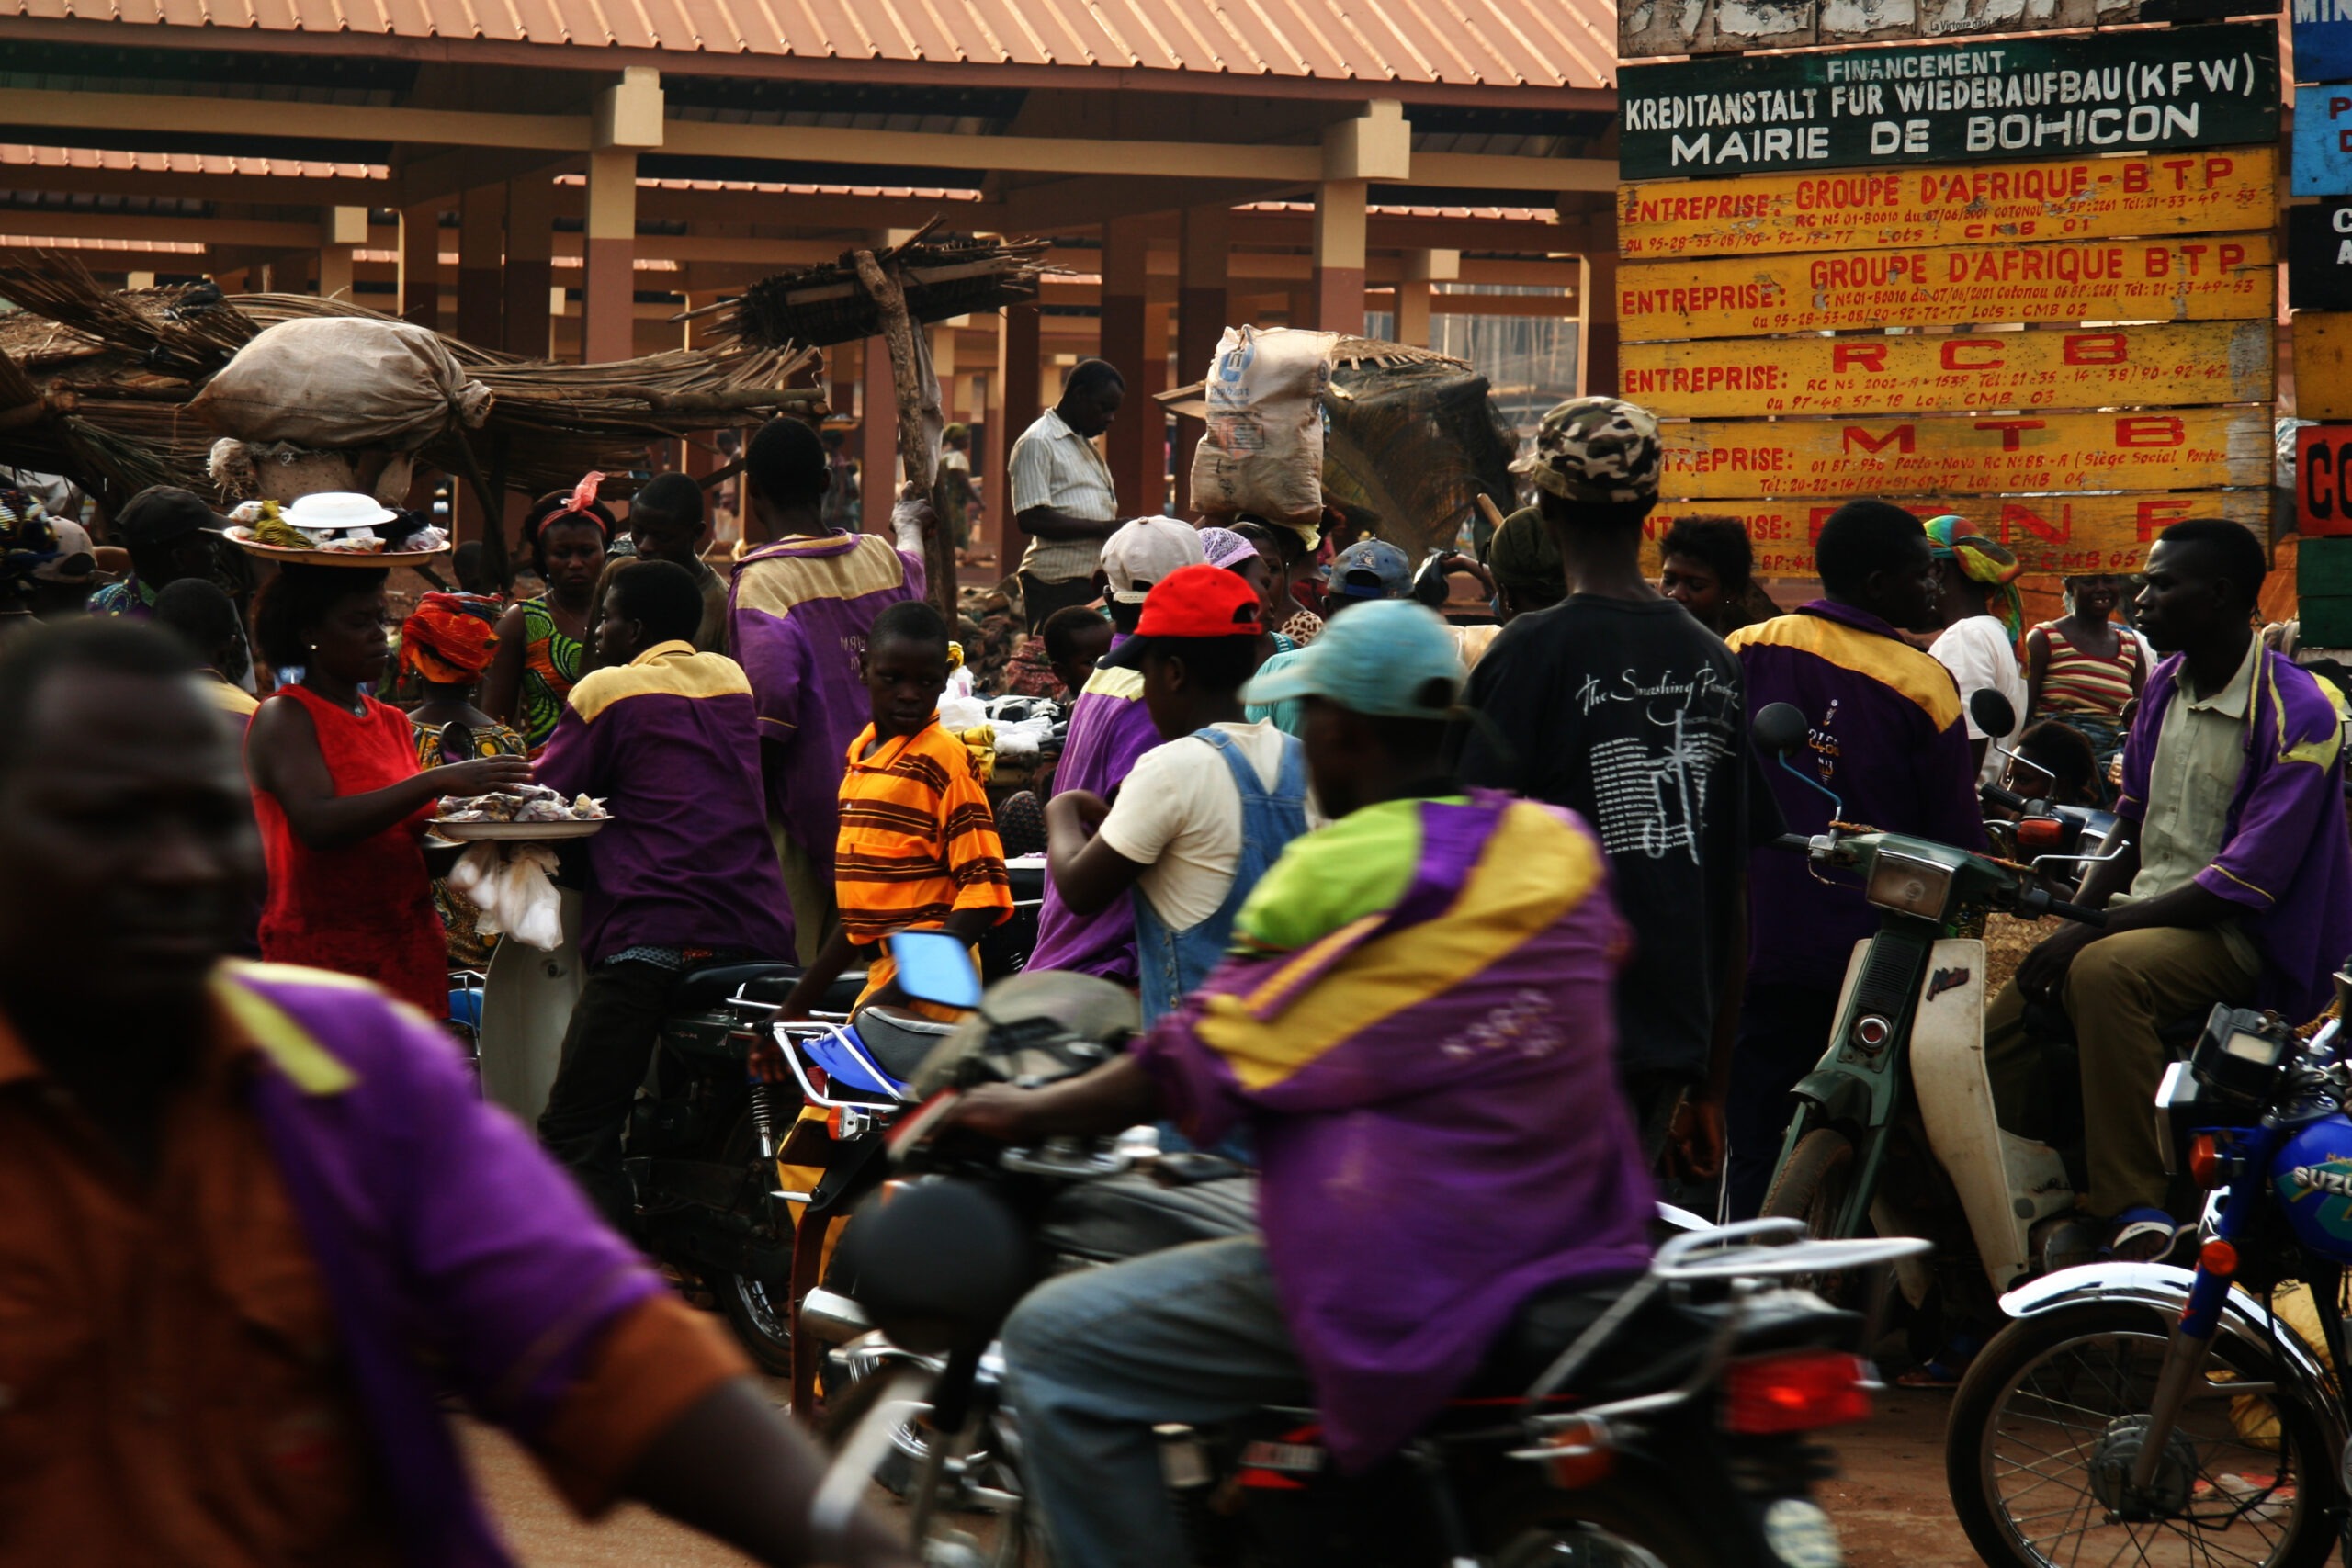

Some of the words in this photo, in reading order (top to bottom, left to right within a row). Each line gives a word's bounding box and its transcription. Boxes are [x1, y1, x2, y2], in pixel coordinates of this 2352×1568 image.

[1940, 19, 1971, 30] Victoire
[1826, 51, 2006, 84] FINANCEMENT
[1626, 87, 1818, 131] KREDITANSTALT
[1671, 126, 1830, 167] MAIRIE
[1870, 119, 1930, 155] DE
[1966, 102, 2199, 152] BOHICON
[1625, 194, 1781, 224] ENTREPRISE:
[1796, 175, 1899, 210] GROUPE
[1795, 214, 1816, 228] RC
[1904, 209, 1920, 223] du
[2064, 218, 2088, 232] 01
[1623, 282, 1786, 315] ENTREPRISE:
[1811, 254, 1928, 290] GROUPE
[1949, 247, 2123, 284] D'AFRIQUE
[1932, 286, 1993, 304] 07/06/2001
[2022, 303, 2059, 318] CMB
[2065, 302, 2087, 317] 02
[1625, 365, 1788, 393] ENTREPRISE:
[1806, 378, 1827, 392] RC
[1963, 391, 2013, 406] CMB
[1661, 447, 1794, 472] TREPRISE:
[2132, 448, 2177, 464] Social
[2009, 471, 2050, 487] CMB
[1575, 673, 1609, 716] The
